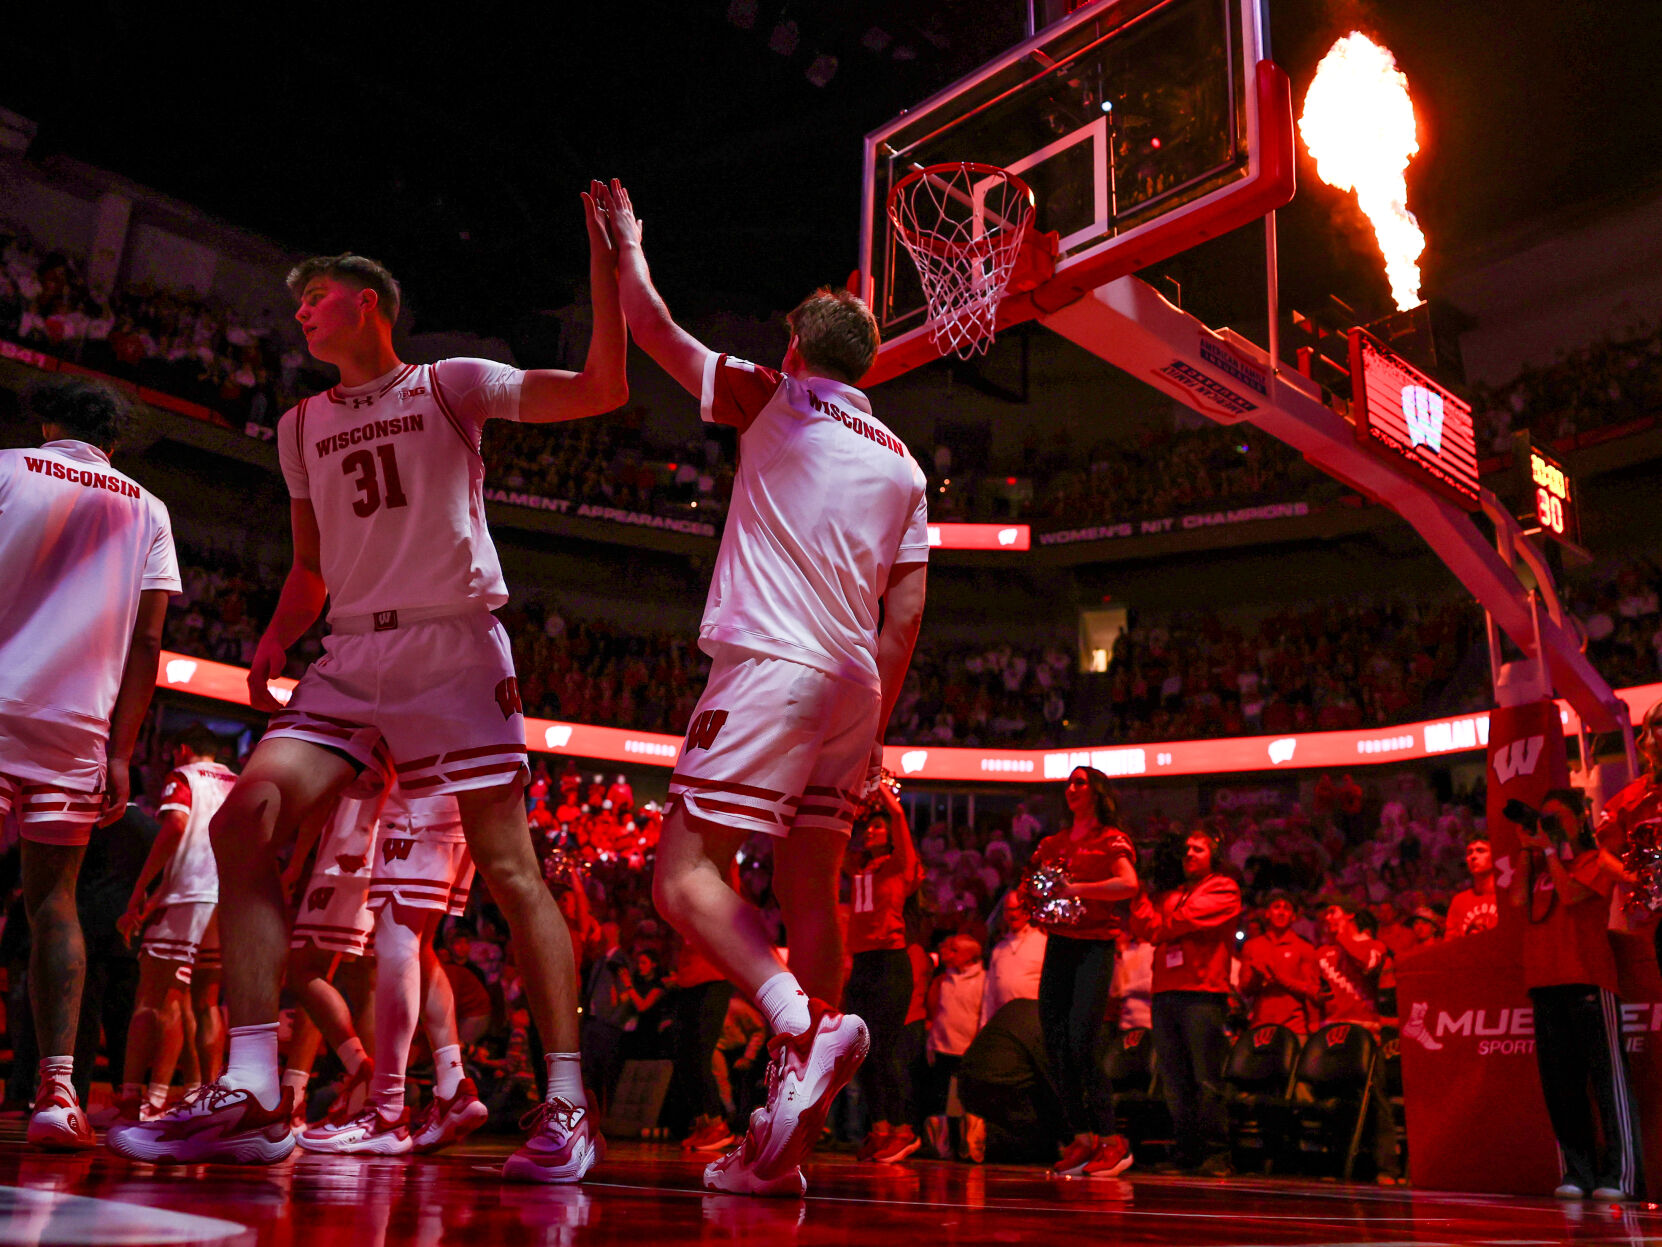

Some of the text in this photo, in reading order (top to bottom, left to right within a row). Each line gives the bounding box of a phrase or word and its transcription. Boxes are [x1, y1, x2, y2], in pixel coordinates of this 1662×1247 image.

[316, 414, 424, 459] WISCONSIN
[807, 389, 905, 457] WISCONSIN
[24, 456, 140, 499] WISCONSIN
[341, 443, 407, 518] 31
[1182, 502, 1309, 529] CHAMPIONS
[1537, 488, 1564, 534] 30
[686, 710, 729, 756] W
[1493, 735, 1544, 785] W
[382, 838, 416, 866] W
